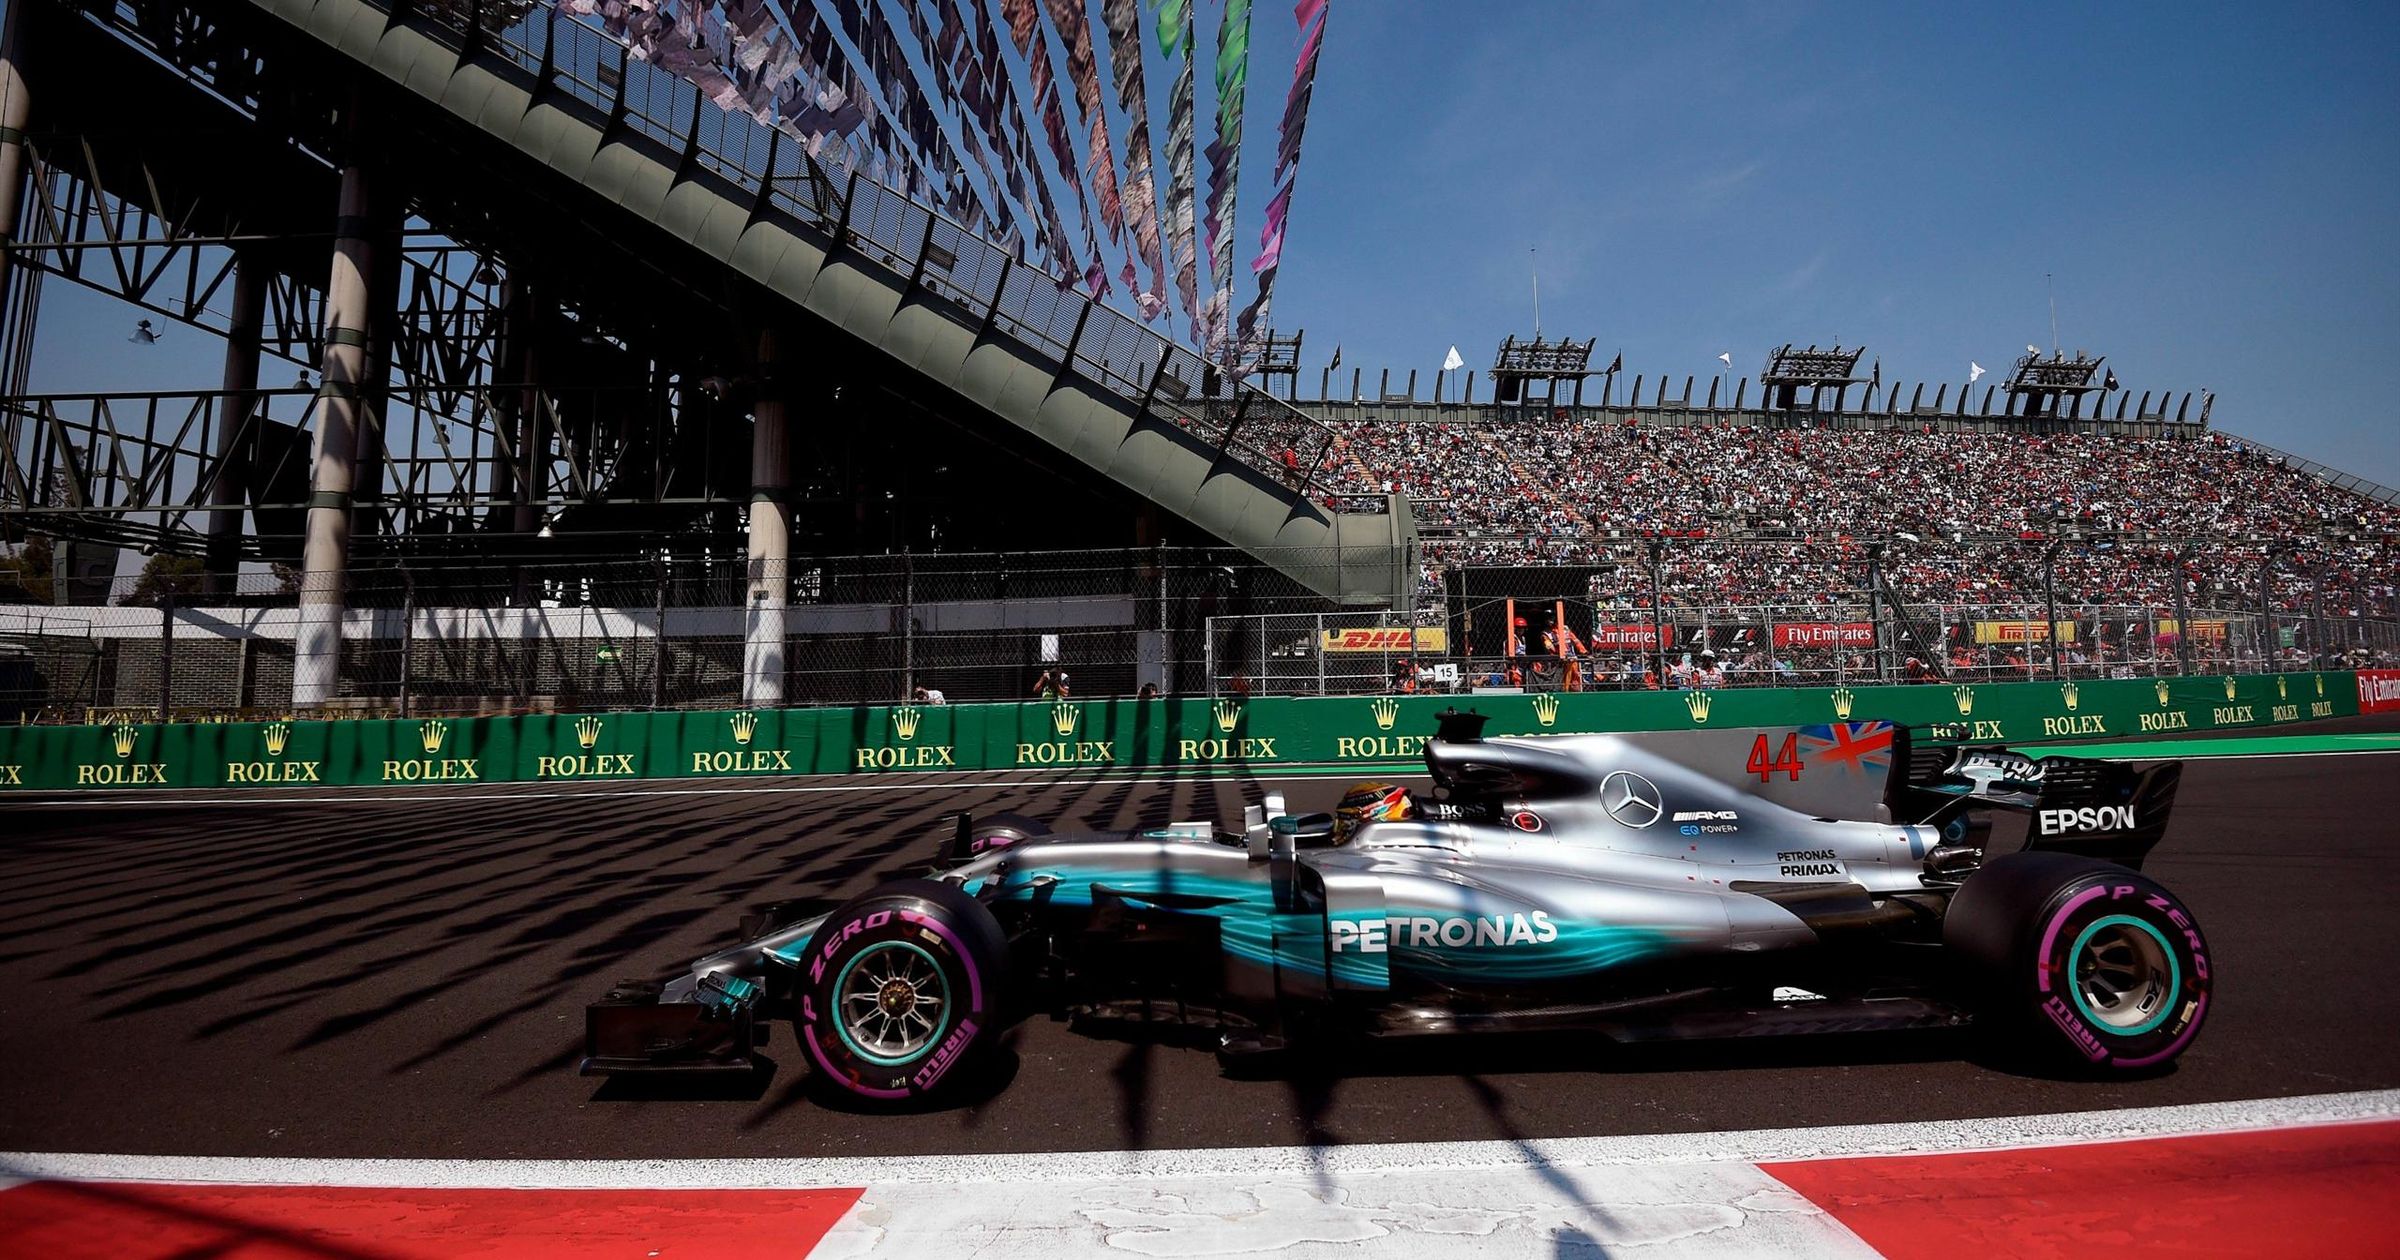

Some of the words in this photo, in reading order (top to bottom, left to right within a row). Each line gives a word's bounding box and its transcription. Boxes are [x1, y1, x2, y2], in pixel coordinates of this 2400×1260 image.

[1342, 631, 1413, 648] DHL
[1598, 628, 1657, 644] Emirates
[1788, 627, 1810, 643] Fly
[1813, 626, 1871, 641] Emirates
[1440, 668, 1453, 678] 15
[2358, 675, 2374, 707] Fly
[2214, 705, 2254, 725] ROLEX
[2273, 704, 2299, 721] ROLEX
[2312, 701, 2332, 717] ROLEX
[2043, 715, 2106, 736] ROLEX
[2140, 711, 2188, 731] ROLEX
[857, 746, 955, 768] ROLEX
[1016, 742, 1115, 764] ROLEX
[1180, 738, 1277, 760] ROLEX
[1746, 733, 1804, 783] 44
[382, 759, 478, 780] ROLEX
[537, 754, 634, 776] ROLEX
[692, 750, 791, 772] ROLEX
[78, 765, 167, 784] ROLEX
[227, 762, 319, 782] ROLEX
[1690, 811, 1738, 821] AMG
[2039, 805, 2136, 835] EPSON
[1680, 825, 1699, 835] EQ
[1777, 849, 1836, 862] PETRONAS
[1780, 863, 1841, 877] PRIMAX
[1330, 910, 1558, 953] PETRONAS
[2112, 885, 2135, 899] P
[2145, 893, 2208, 979] ZERO
[809, 910, 892, 984] ZERO
[803, 994, 817, 1021] P
[2041, 996, 2108, 1061] PIRELLI
[912, 1018, 978, 1090] PIRELLI
